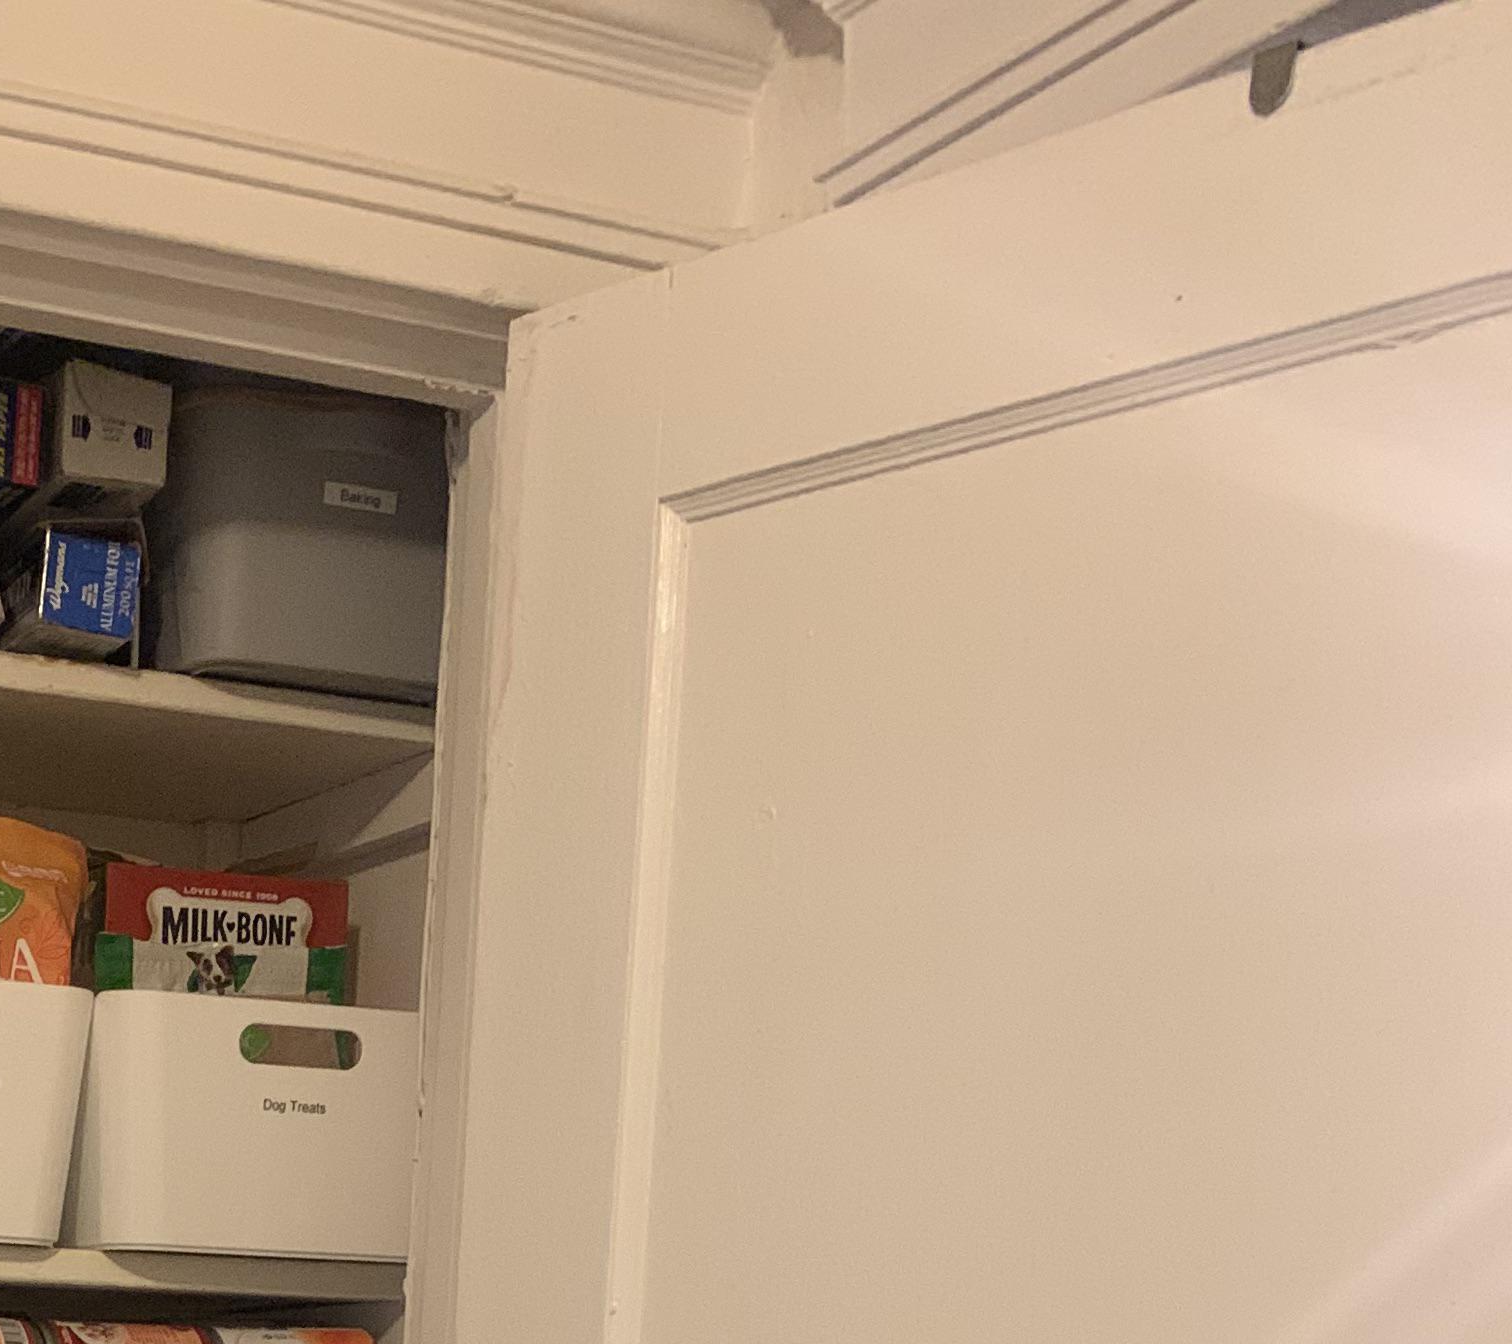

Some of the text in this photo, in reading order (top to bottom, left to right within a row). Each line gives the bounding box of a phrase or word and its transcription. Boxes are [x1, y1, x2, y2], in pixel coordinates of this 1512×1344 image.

[46, 541, 69, 611] Wegmans
[99, 566, 118, 632] ALUMINUM
[119, 590, 132, 616] 200
[184, 886, 218, 897] LOVED
[221, 889, 252, 899] SINCE
[262, 1098, 327, 1115] Dog Treats
